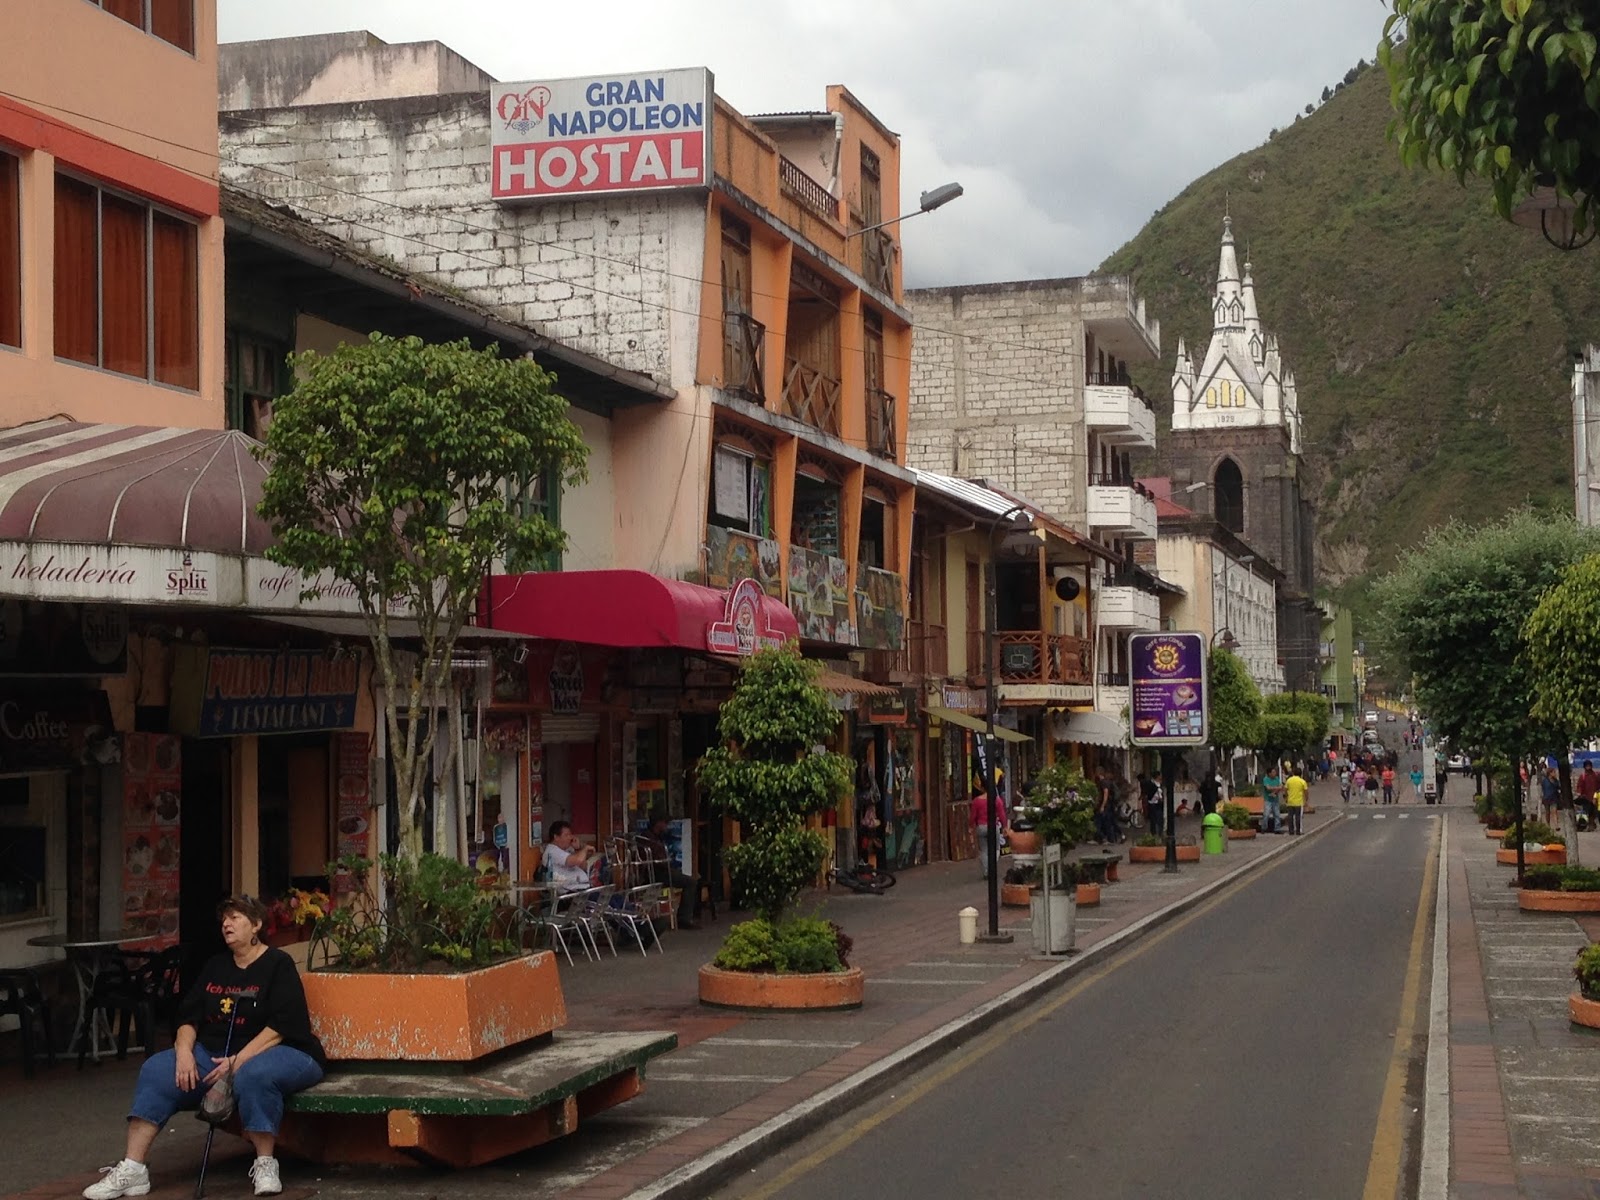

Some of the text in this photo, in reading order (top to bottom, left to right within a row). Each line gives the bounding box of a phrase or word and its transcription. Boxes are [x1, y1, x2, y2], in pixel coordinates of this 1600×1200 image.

[585, 77, 665, 107] GRAN
[548, 102, 703, 137] NAPOLEON
[499, 138, 699, 191] HOSTAL
[11, 554, 137, 586] heladería
[167, 571, 207, 596] Split
[259, 566, 298, 601] café
[550, 670, 583, 692] Sweet
[554, 690, 578, 710] Kiss
[0, 700, 69, 740] Coffee
